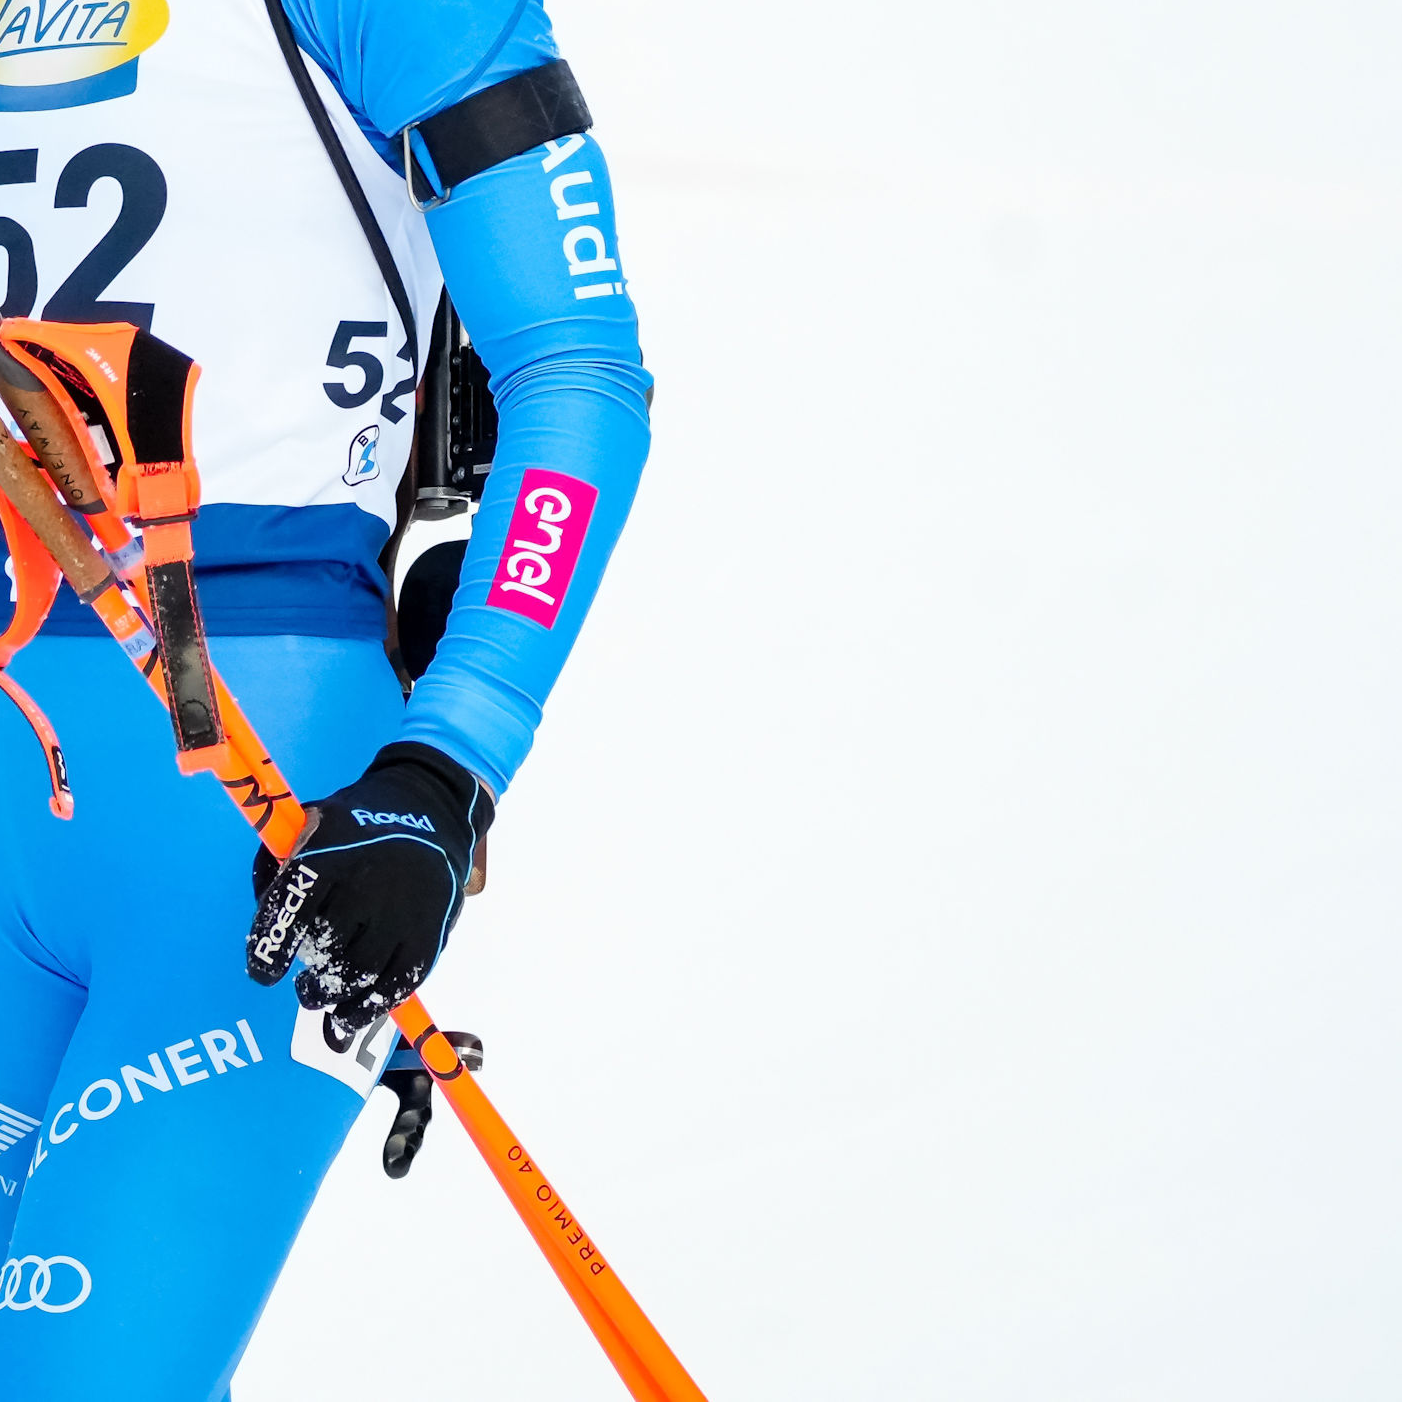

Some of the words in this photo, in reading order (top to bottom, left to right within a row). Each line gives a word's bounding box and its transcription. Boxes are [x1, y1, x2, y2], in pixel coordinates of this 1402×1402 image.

[500, 486, 573, 607] enel
[507, 1145, 533, 1174] 40
[536, 1184, 606, 1276] PREMIO
